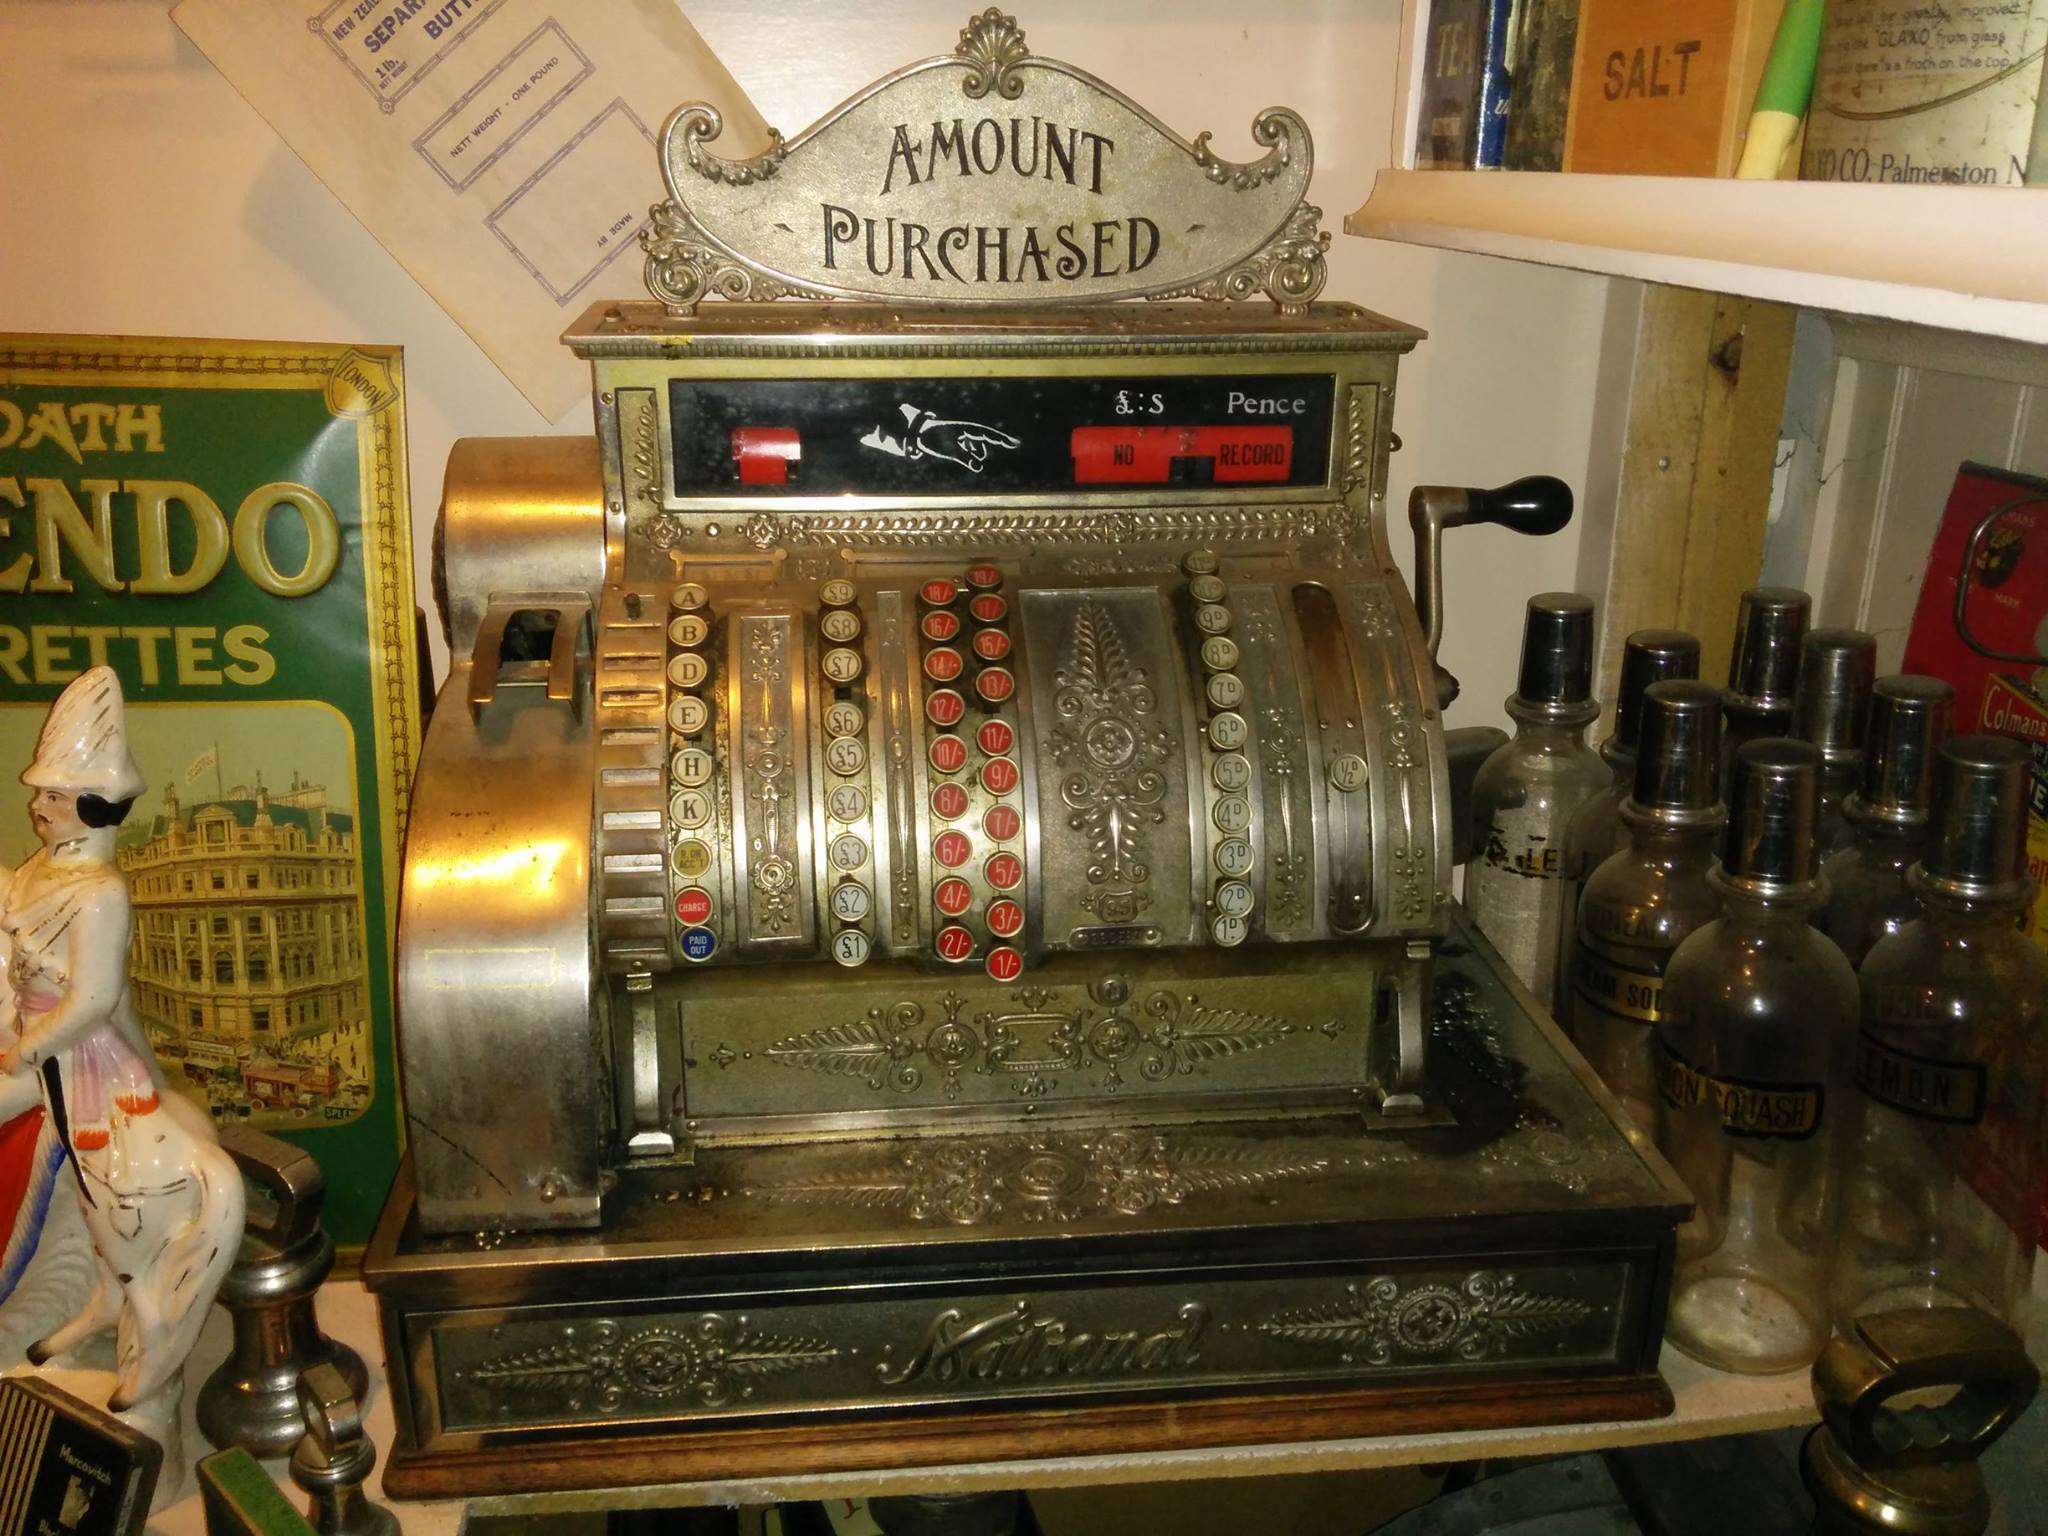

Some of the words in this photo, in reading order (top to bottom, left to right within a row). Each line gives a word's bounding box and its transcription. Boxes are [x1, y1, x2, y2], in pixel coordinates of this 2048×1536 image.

[332, 16, 356, 41] NEW
[1603, 40, 1702, 101] SALT
[1939, 60, 1954, 69] on
[1959, 56, 1982, 68] the
[449, 136, 473, 159] NETT
[472, 107, 503, 138] WEIGHT
[511, 83, 531, 102] ONE
[529, 56, 560, 86] POUND
[879, 115, 1115, 197] AMOUNT
[609, 212, 633, 236] MADE
[596, 234, 609, 248] BY
[819, 203, 1161, 285] PURCHASED
[335, 360, 389, 409] LONDON
[1227, 391, 1306, 415] Pence
[1113, 445, 1135, 466] NO
[1219, 444, 1285, 466] RECORD
[682, 591, 697, 605] A
[682, 625, 697, 641] B
[831, 618, 850, 636] £8
[682, 662, 698, 680] D
[832, 655, 852, 678] £7
[681, 706, 697, 725] E
[832, 710, 853, 733] £6
[933, 699, 960, 721] 12/-
[984, 726, 1010, 749] 11/-
[684, 757, 700, 777] H
[835, 743, 857, 769] £5
[936, 743, 963, 767] 10/-
[991, 765, 1016, 788] 9/-
[682, 799, 698, 820] K
[837, 789, 859, 816] £4
[940, 788, 963, 813] 8/-
[839, 839, 859, 866] £3
[942, 839, 966, 864] 6/-
[995, 861, 1019, 886] 5/-
[679, 902, 707, 913] CHARGE
[839, 888, 860, 914] £2
[943, 884, 968, 909] 4/-
[996, 905, 1019, 931] 3/-
[688, 935, 707, 945] PAID
[690, 945, 707, 955] OUT
[841, 934, 861, 959] £1
[944, 933, 968, 958] 2/-
[998, 954, 1018, 977] 1/-
[876, 1300, 1212, 1385] National
